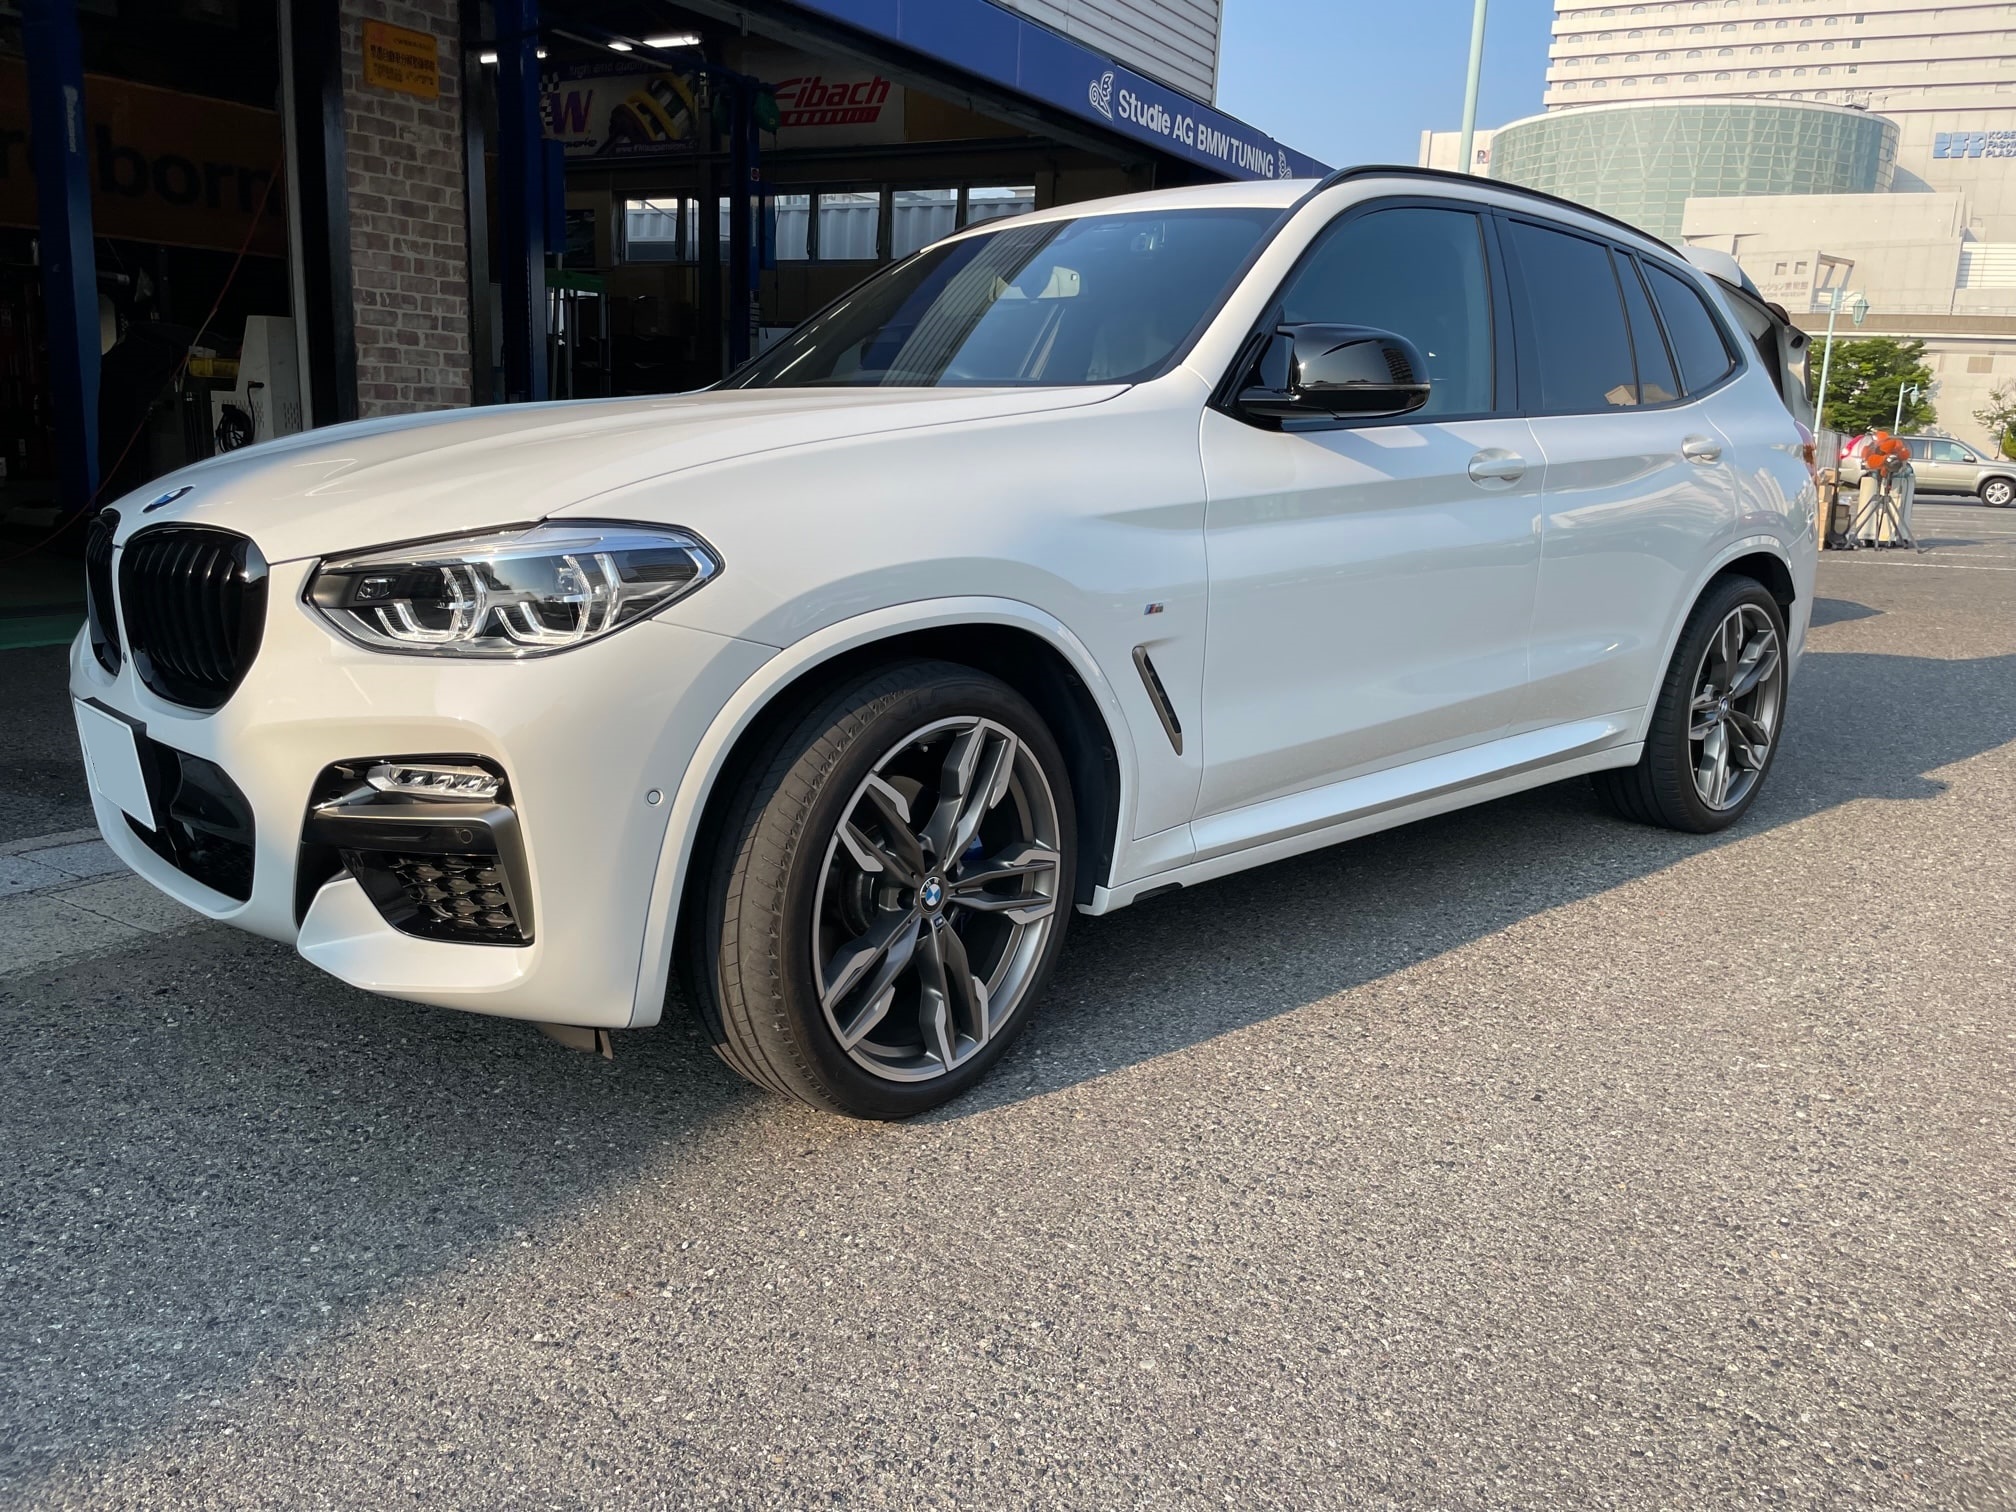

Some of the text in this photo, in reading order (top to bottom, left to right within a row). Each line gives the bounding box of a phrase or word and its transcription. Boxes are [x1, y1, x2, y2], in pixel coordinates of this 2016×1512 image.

[774, 75, 891, 108] Eibach
[1118, 89, 1274, 178] Studie AG BMW TUNING
